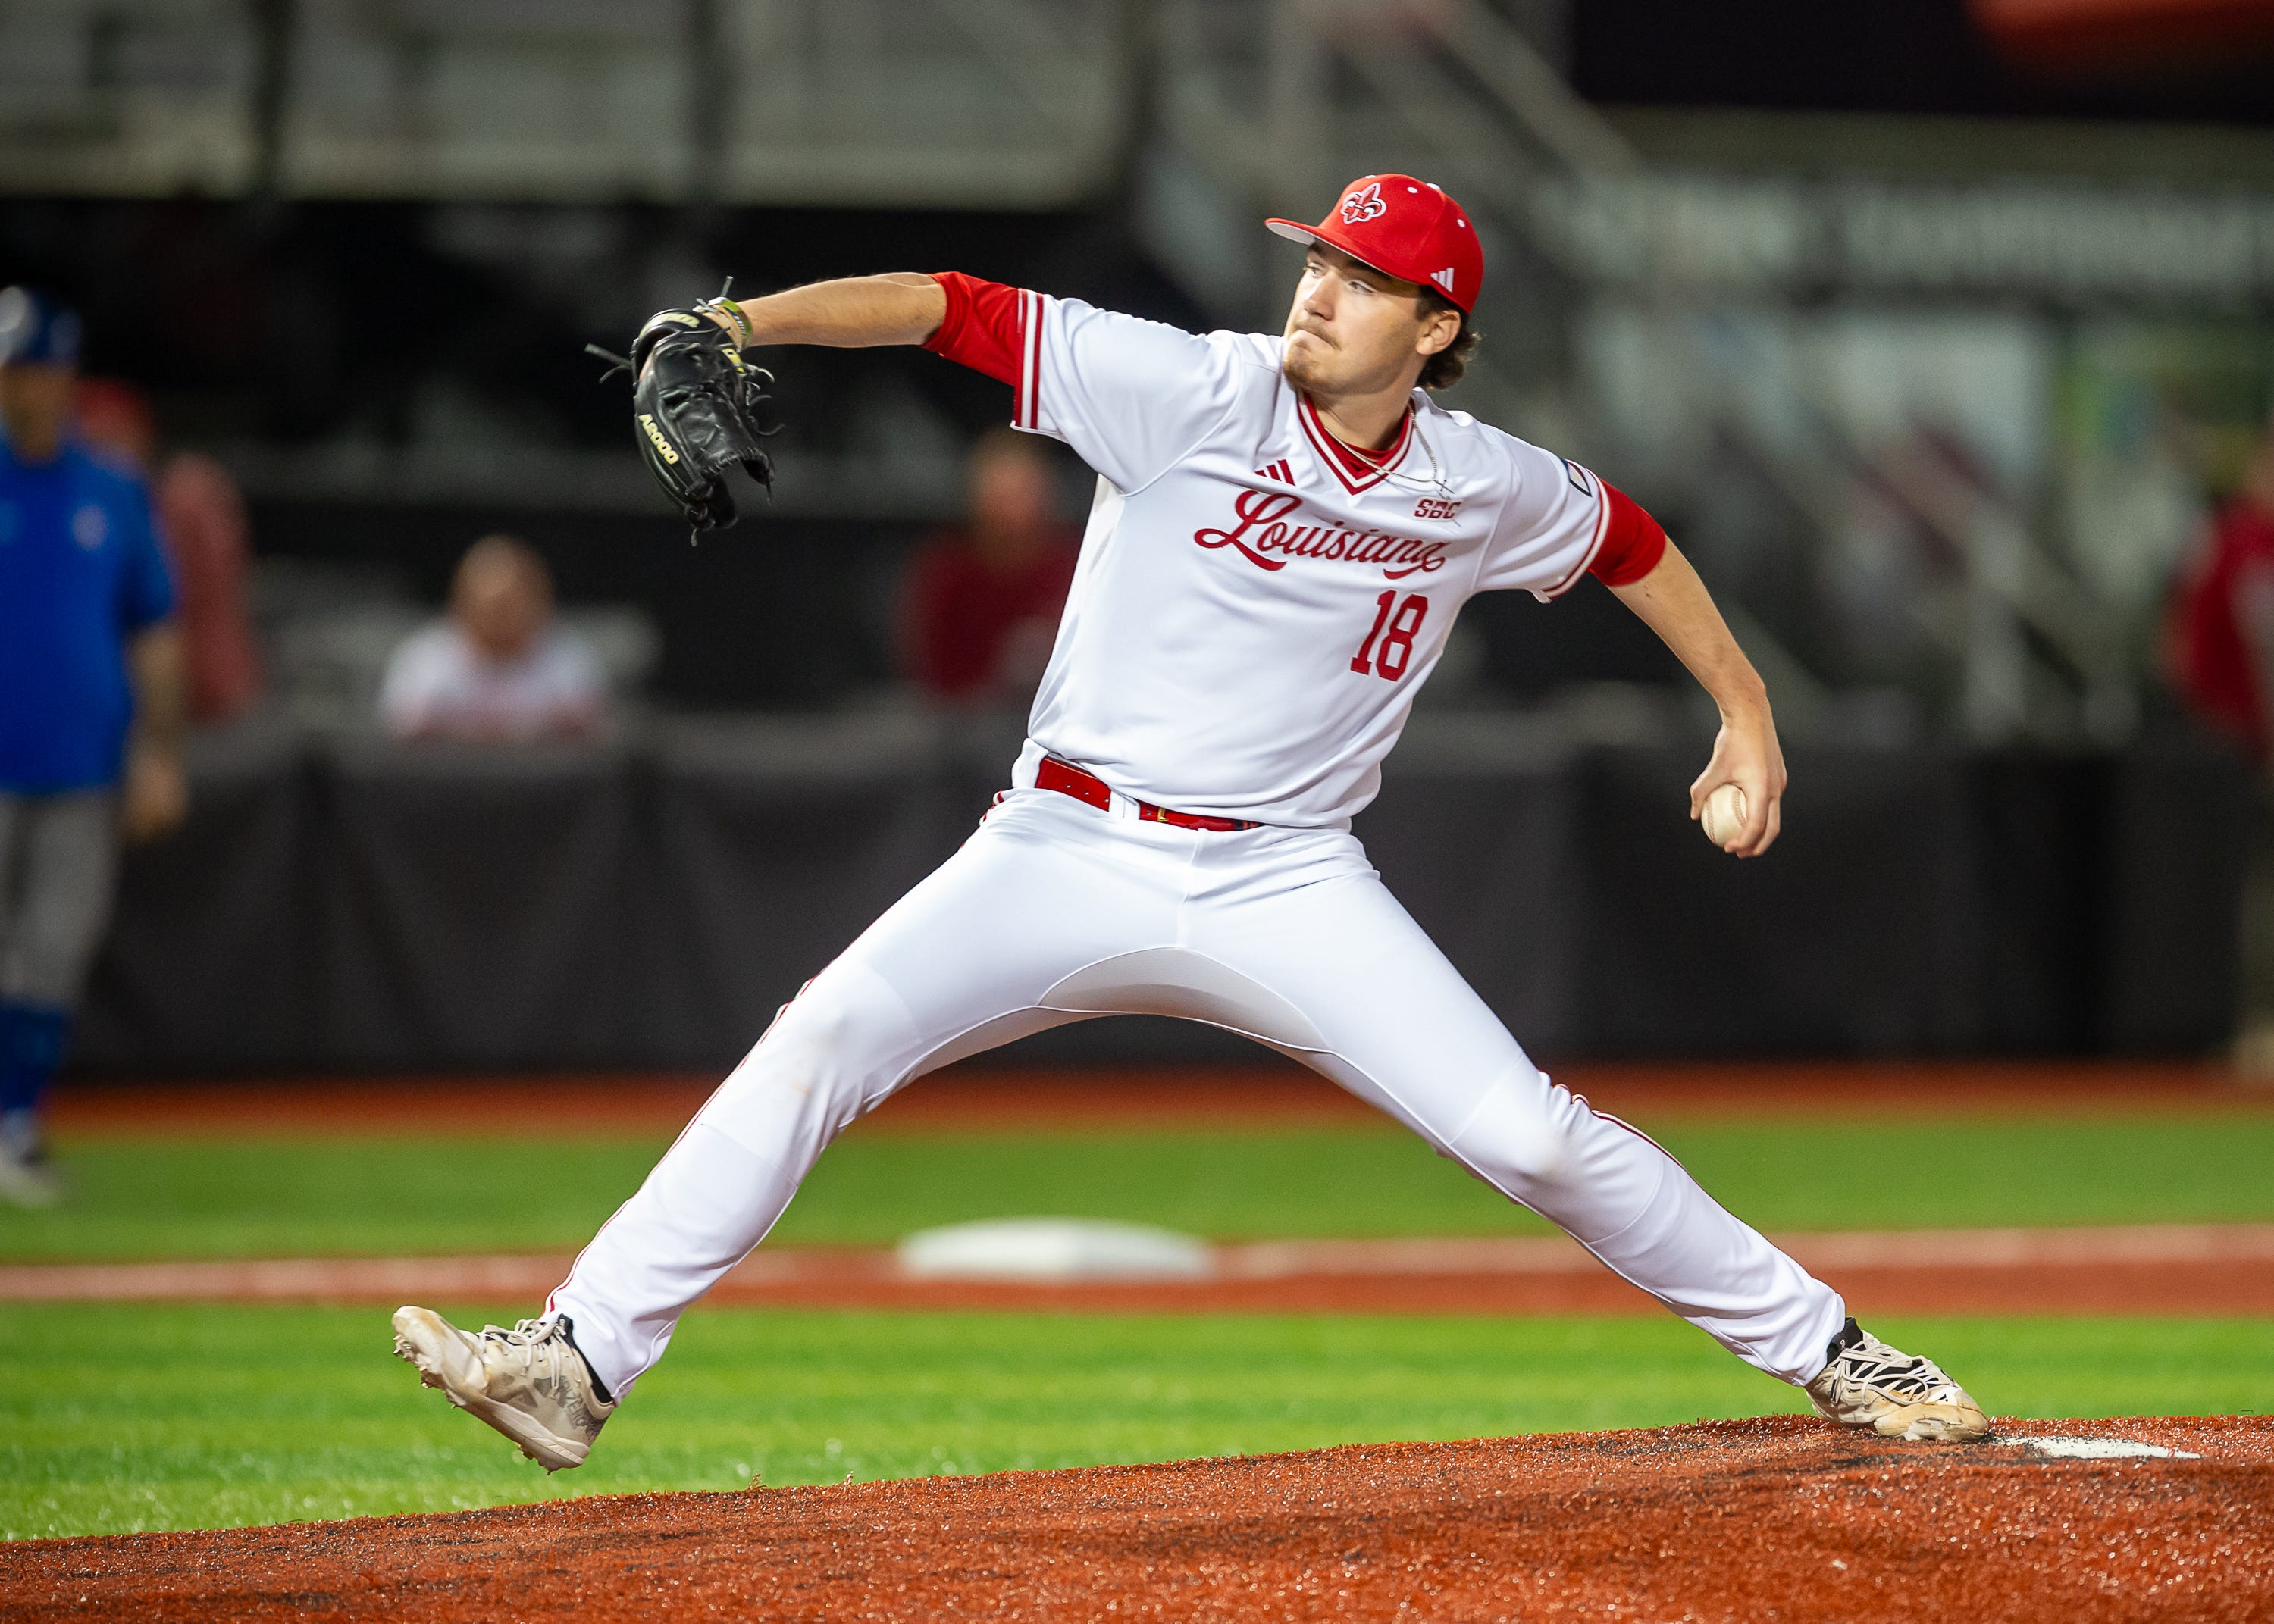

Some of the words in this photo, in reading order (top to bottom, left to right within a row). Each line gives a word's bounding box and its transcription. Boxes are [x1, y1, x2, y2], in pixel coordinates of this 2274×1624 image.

[638, 413, 679, 465] A2000
[1194, 490, 1449, 579] Louisiana
[1414, 499, 1461, 519] SBC
[1350, 590, 1428, 682] 18
